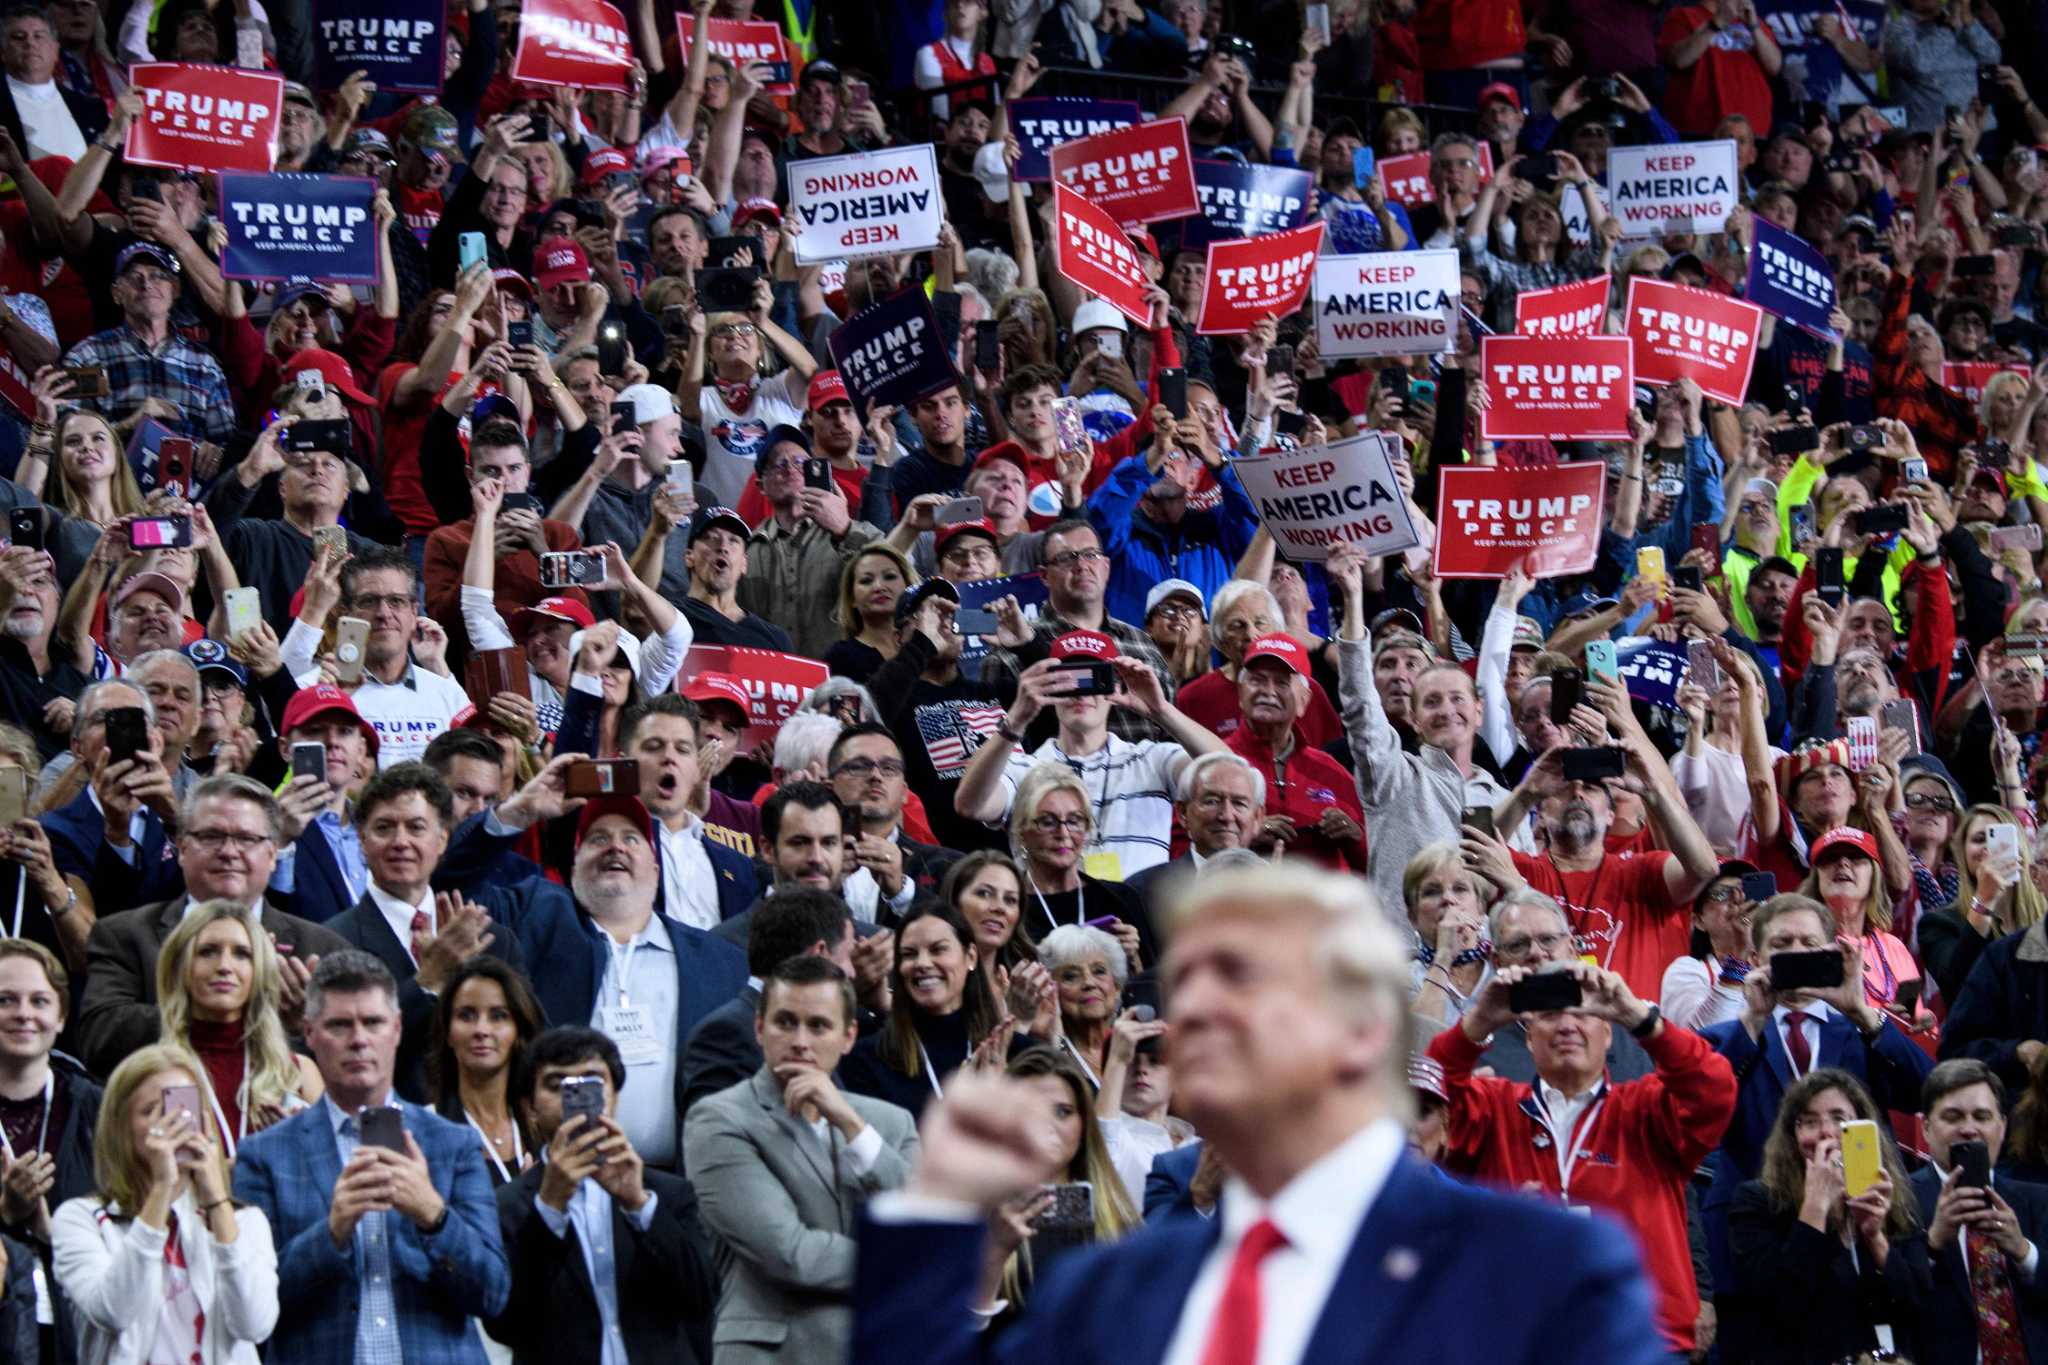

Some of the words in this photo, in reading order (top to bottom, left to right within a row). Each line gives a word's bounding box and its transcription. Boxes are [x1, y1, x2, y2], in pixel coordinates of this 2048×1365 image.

[320, 18, 435, 39] TRUMP
[328, 40, 423, 54] PENCE
[142, 87, 269, 123] TRUMP
[151, 111, 255, 138] PENCE
[1061, 146, 1179, 185] TRUMP
[1645, 156, 1696, 173] KEEP
[805, 165, 920, 195] WORKING
[1616, 175, 1729, 200] AMERICA
[798, 189, 931, 225] AMERICA
[1197, 185, 1300, 214] TRUMP
[1624, 201, 1723, 222] WORKING
[231, 202, 367, 227] TRUMP
[244, 226, 355, 243] PENCE
[840, 224, 900, 247] KEEP
[1071, 235, 1141, 282] PENCE
[1217, 250, 1314, 287] TRUMP
[1758, 241, 1833, 291] TRUMP
[1224, 272, 1305, 301] PENCE
[1359, 265, 1416, 285] KEEP
[1763, 263, 1831, 304] PENCE
[1323, 288, 1453, 316] AMERICA
[1332, 319, 1446, 341] WORKING
[1524, 303, 1602, 335] TRUMP
[1637, 306, 1749, 348] TRUMP
[841, 316, 925, 376] TRUMP
[1645, 330, 1737, 364] PENCE
[852, 342, 924, 389] PENCE
[1493, 365, 1622, 384] TRUMP
[1505, 386, 1611, 399] PENCE
[1273, 461, 1337, 488] KEEP
[1260, 479, 1395, 522] AMERICA
[1452, 494, 1592, 520] TRUMP
[1283, 515, 1394, 546] WORKING
[1463, 518, 1577, 536] PENCE
[1255, 638, 1297, 652] TRUMP
[374, 721, 438, 733] RUMP
